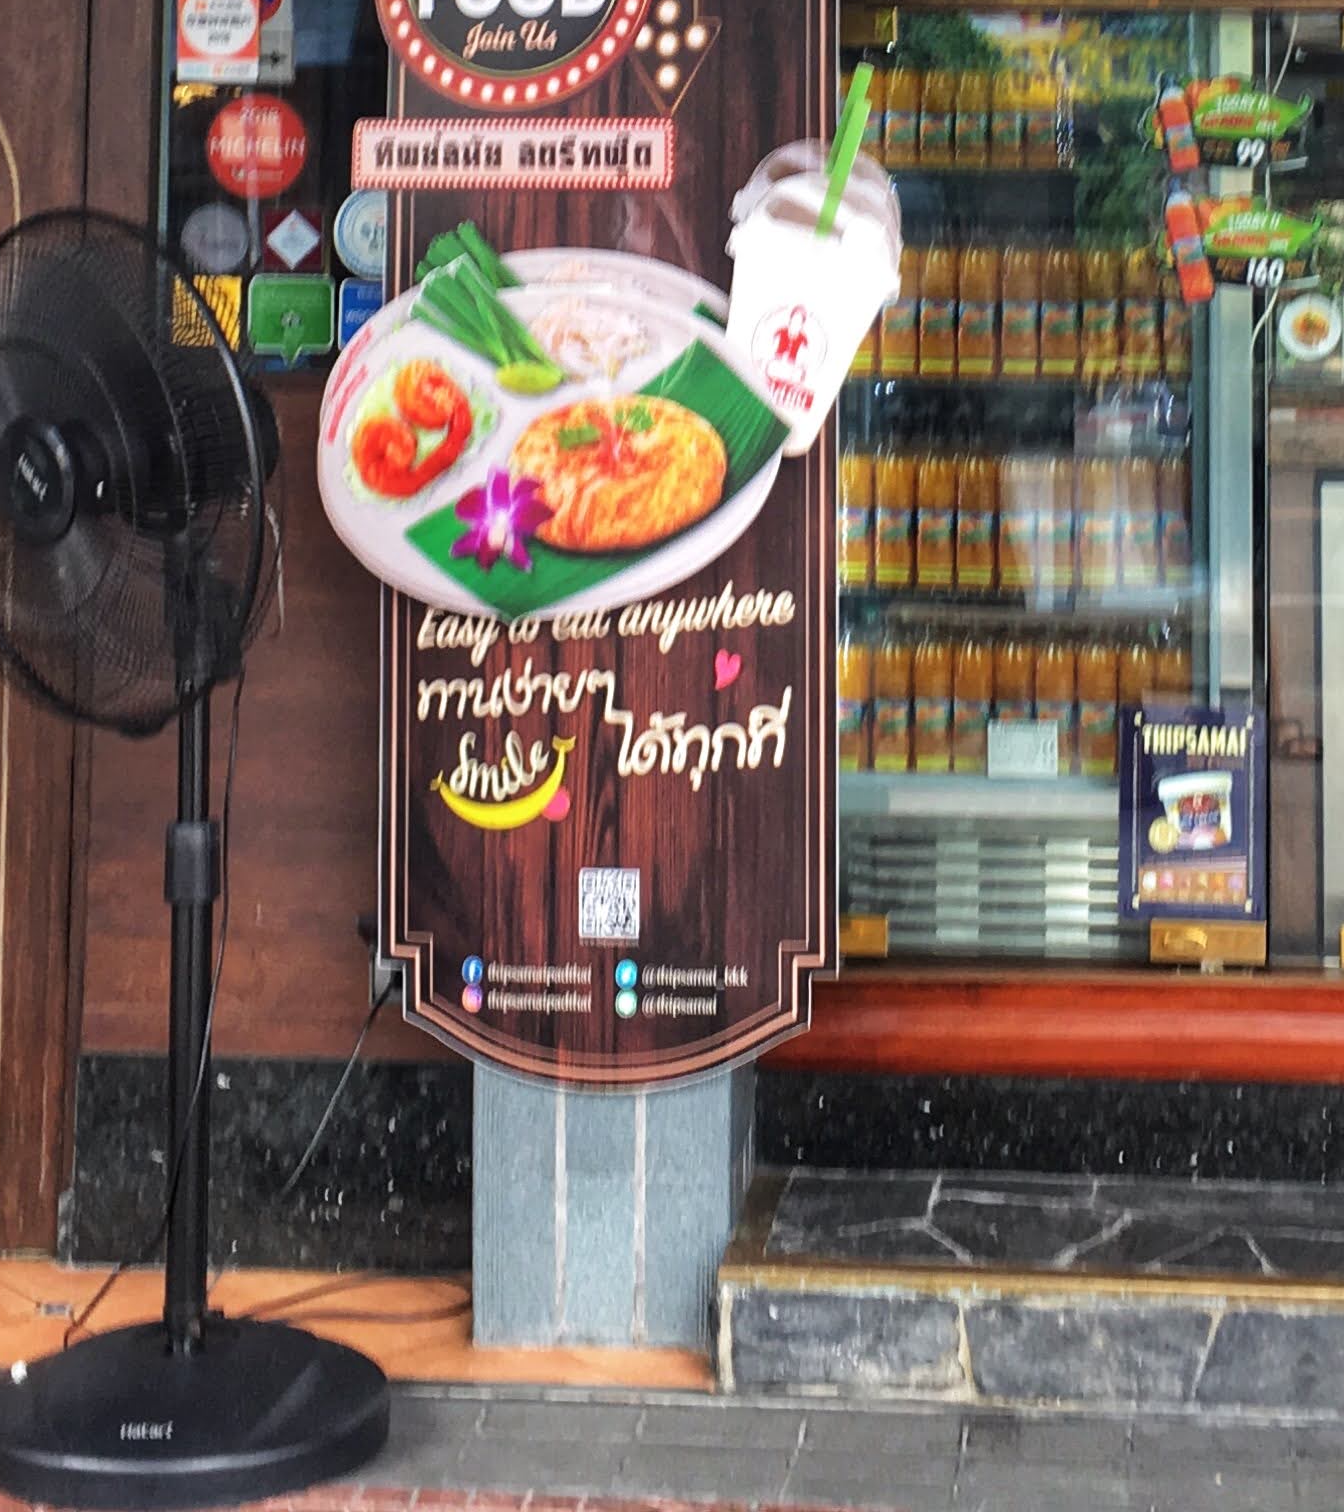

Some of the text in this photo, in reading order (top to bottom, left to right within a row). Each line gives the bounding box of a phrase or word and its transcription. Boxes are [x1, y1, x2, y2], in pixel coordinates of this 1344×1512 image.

[463, 21, 559, 60] Join Us
[209, 135, 306, 158] MICHELIN
[1237, 138, 1266, 168] 99
[1246, 257, 1286, 288] 160
[618, 579, 796, 655] anywhere
[1142, 724, 1247, 757] THIPSAMAI
[449, 730, 551, 802] Smile
